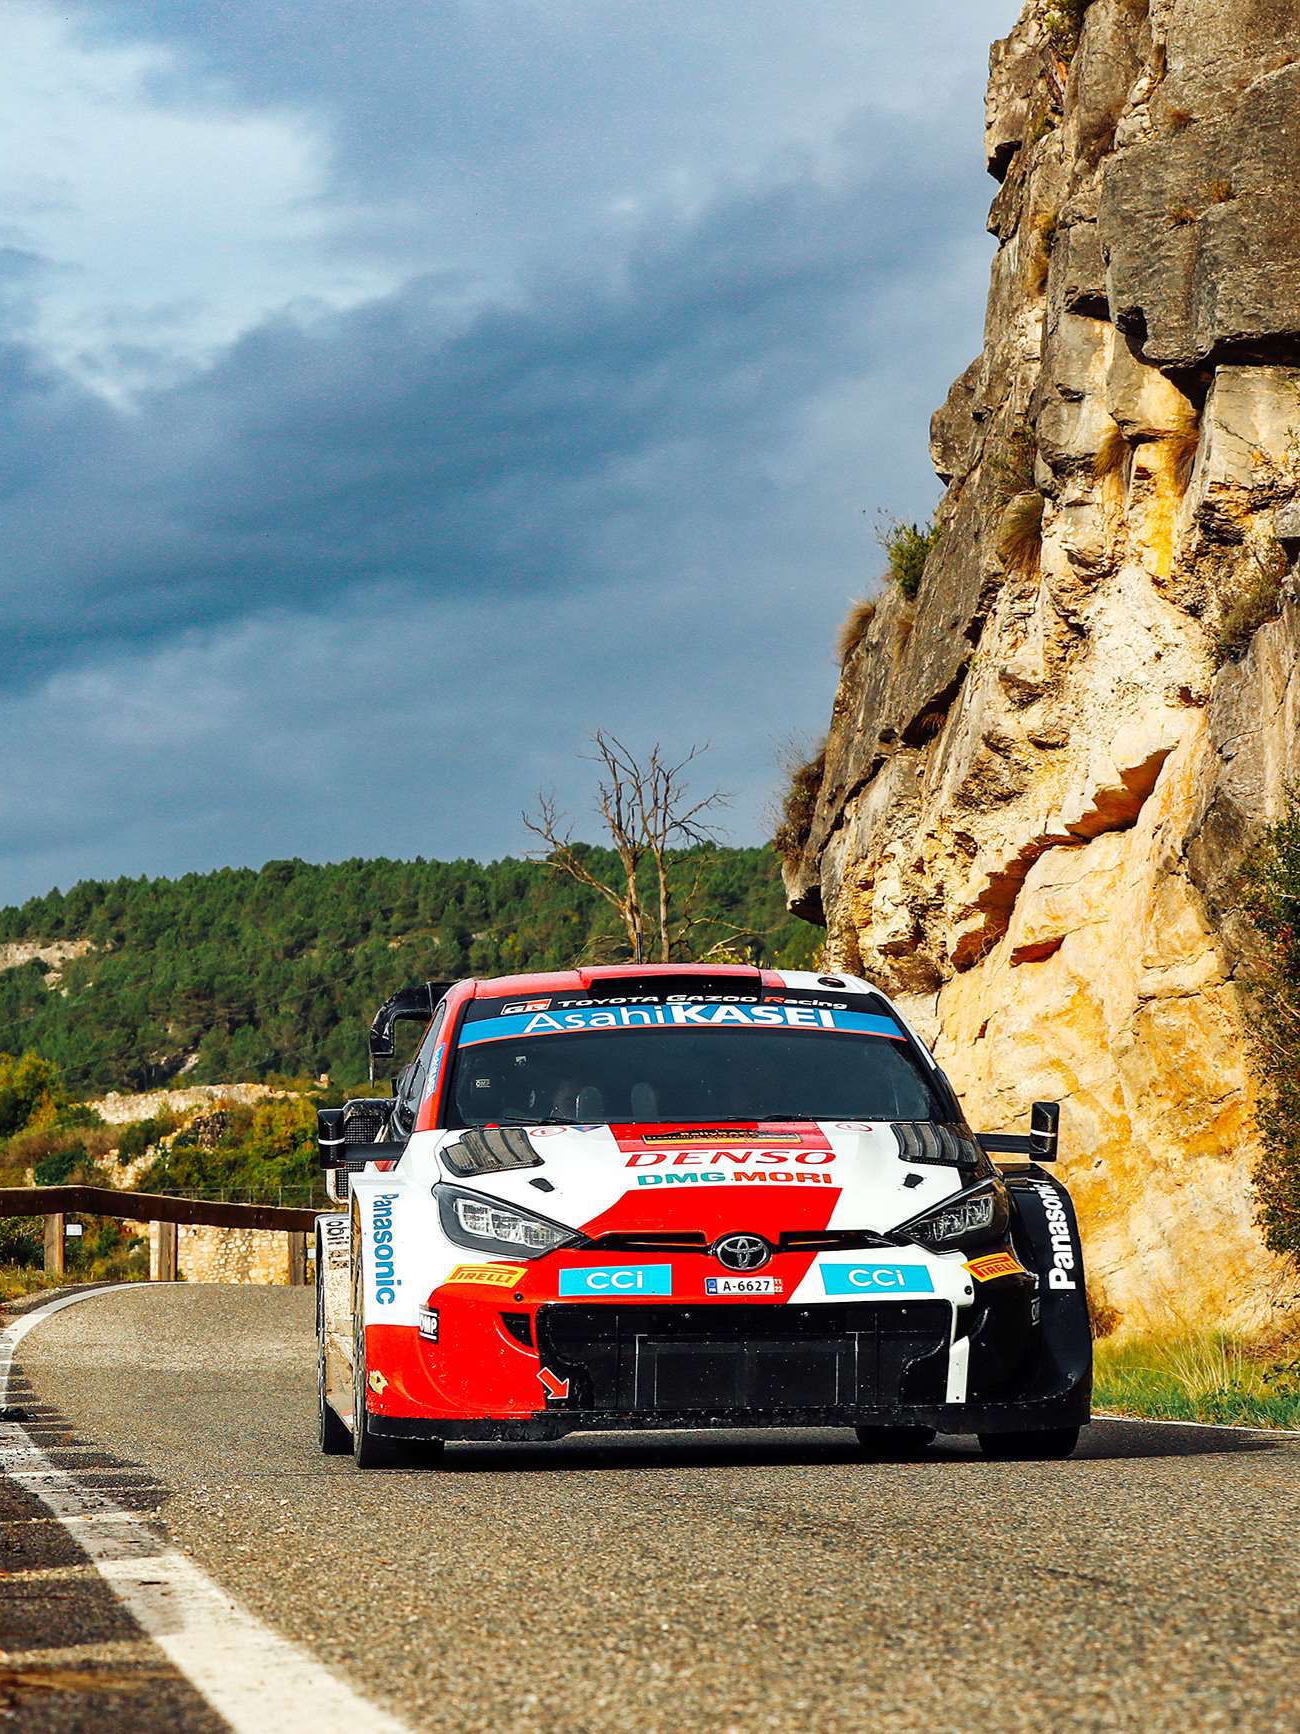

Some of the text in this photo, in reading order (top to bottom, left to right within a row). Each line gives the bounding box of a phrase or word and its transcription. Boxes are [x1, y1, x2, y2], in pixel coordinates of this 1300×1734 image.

[558, 996, 659, 1008] TOYOTA
[666, 994, 758, 1002] GAZOO
[764, 996, 848, 1010] Racing
[625, 1151, 837, 1167] DENSO
[637, 1171, 833, 1185] DMG MORI
[1029, 1184, 1077, 1290] Panasonic
[373, 1193, 402, 1305] Panasonic
[449, 1266, 518, 1283] PIRELLI
[969, 1257, 1021, 1278] PIRELLI
[723, 1280, 770, 1292] A-6627
